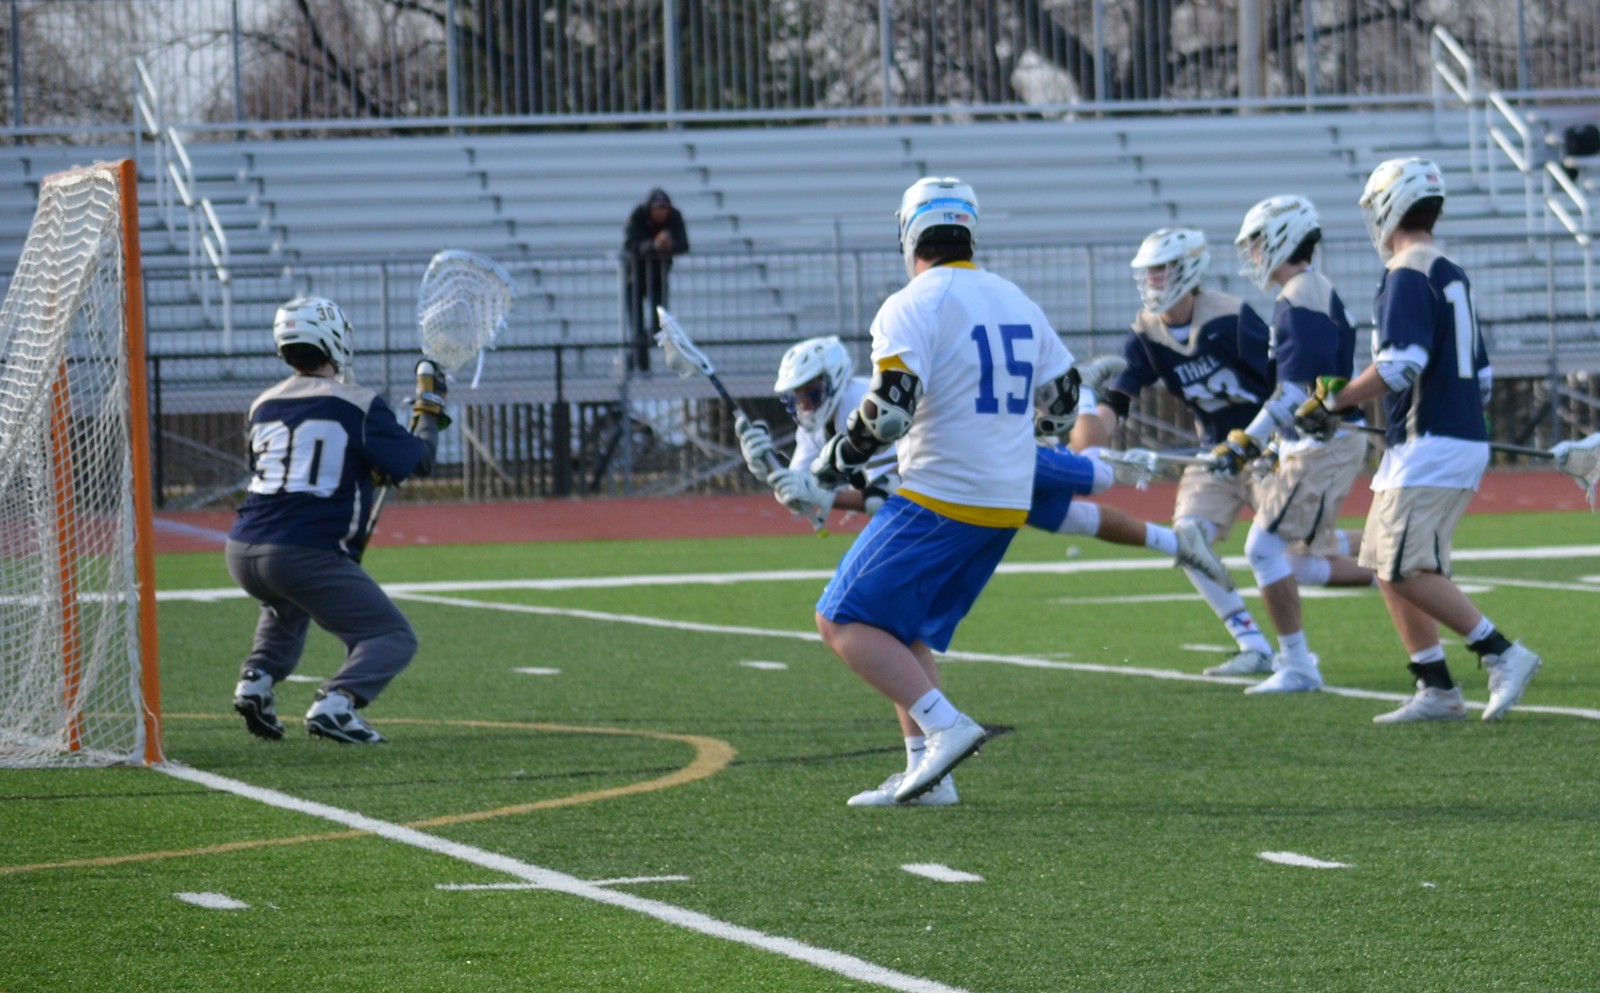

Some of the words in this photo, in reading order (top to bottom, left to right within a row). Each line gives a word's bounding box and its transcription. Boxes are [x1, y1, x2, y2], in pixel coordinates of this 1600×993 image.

[316, 306, 336, 322] 30
[1442, 280, 1477, 379] 1
[971, 324, 1034, 415] 15
[248, 418, 349, 498] 30
